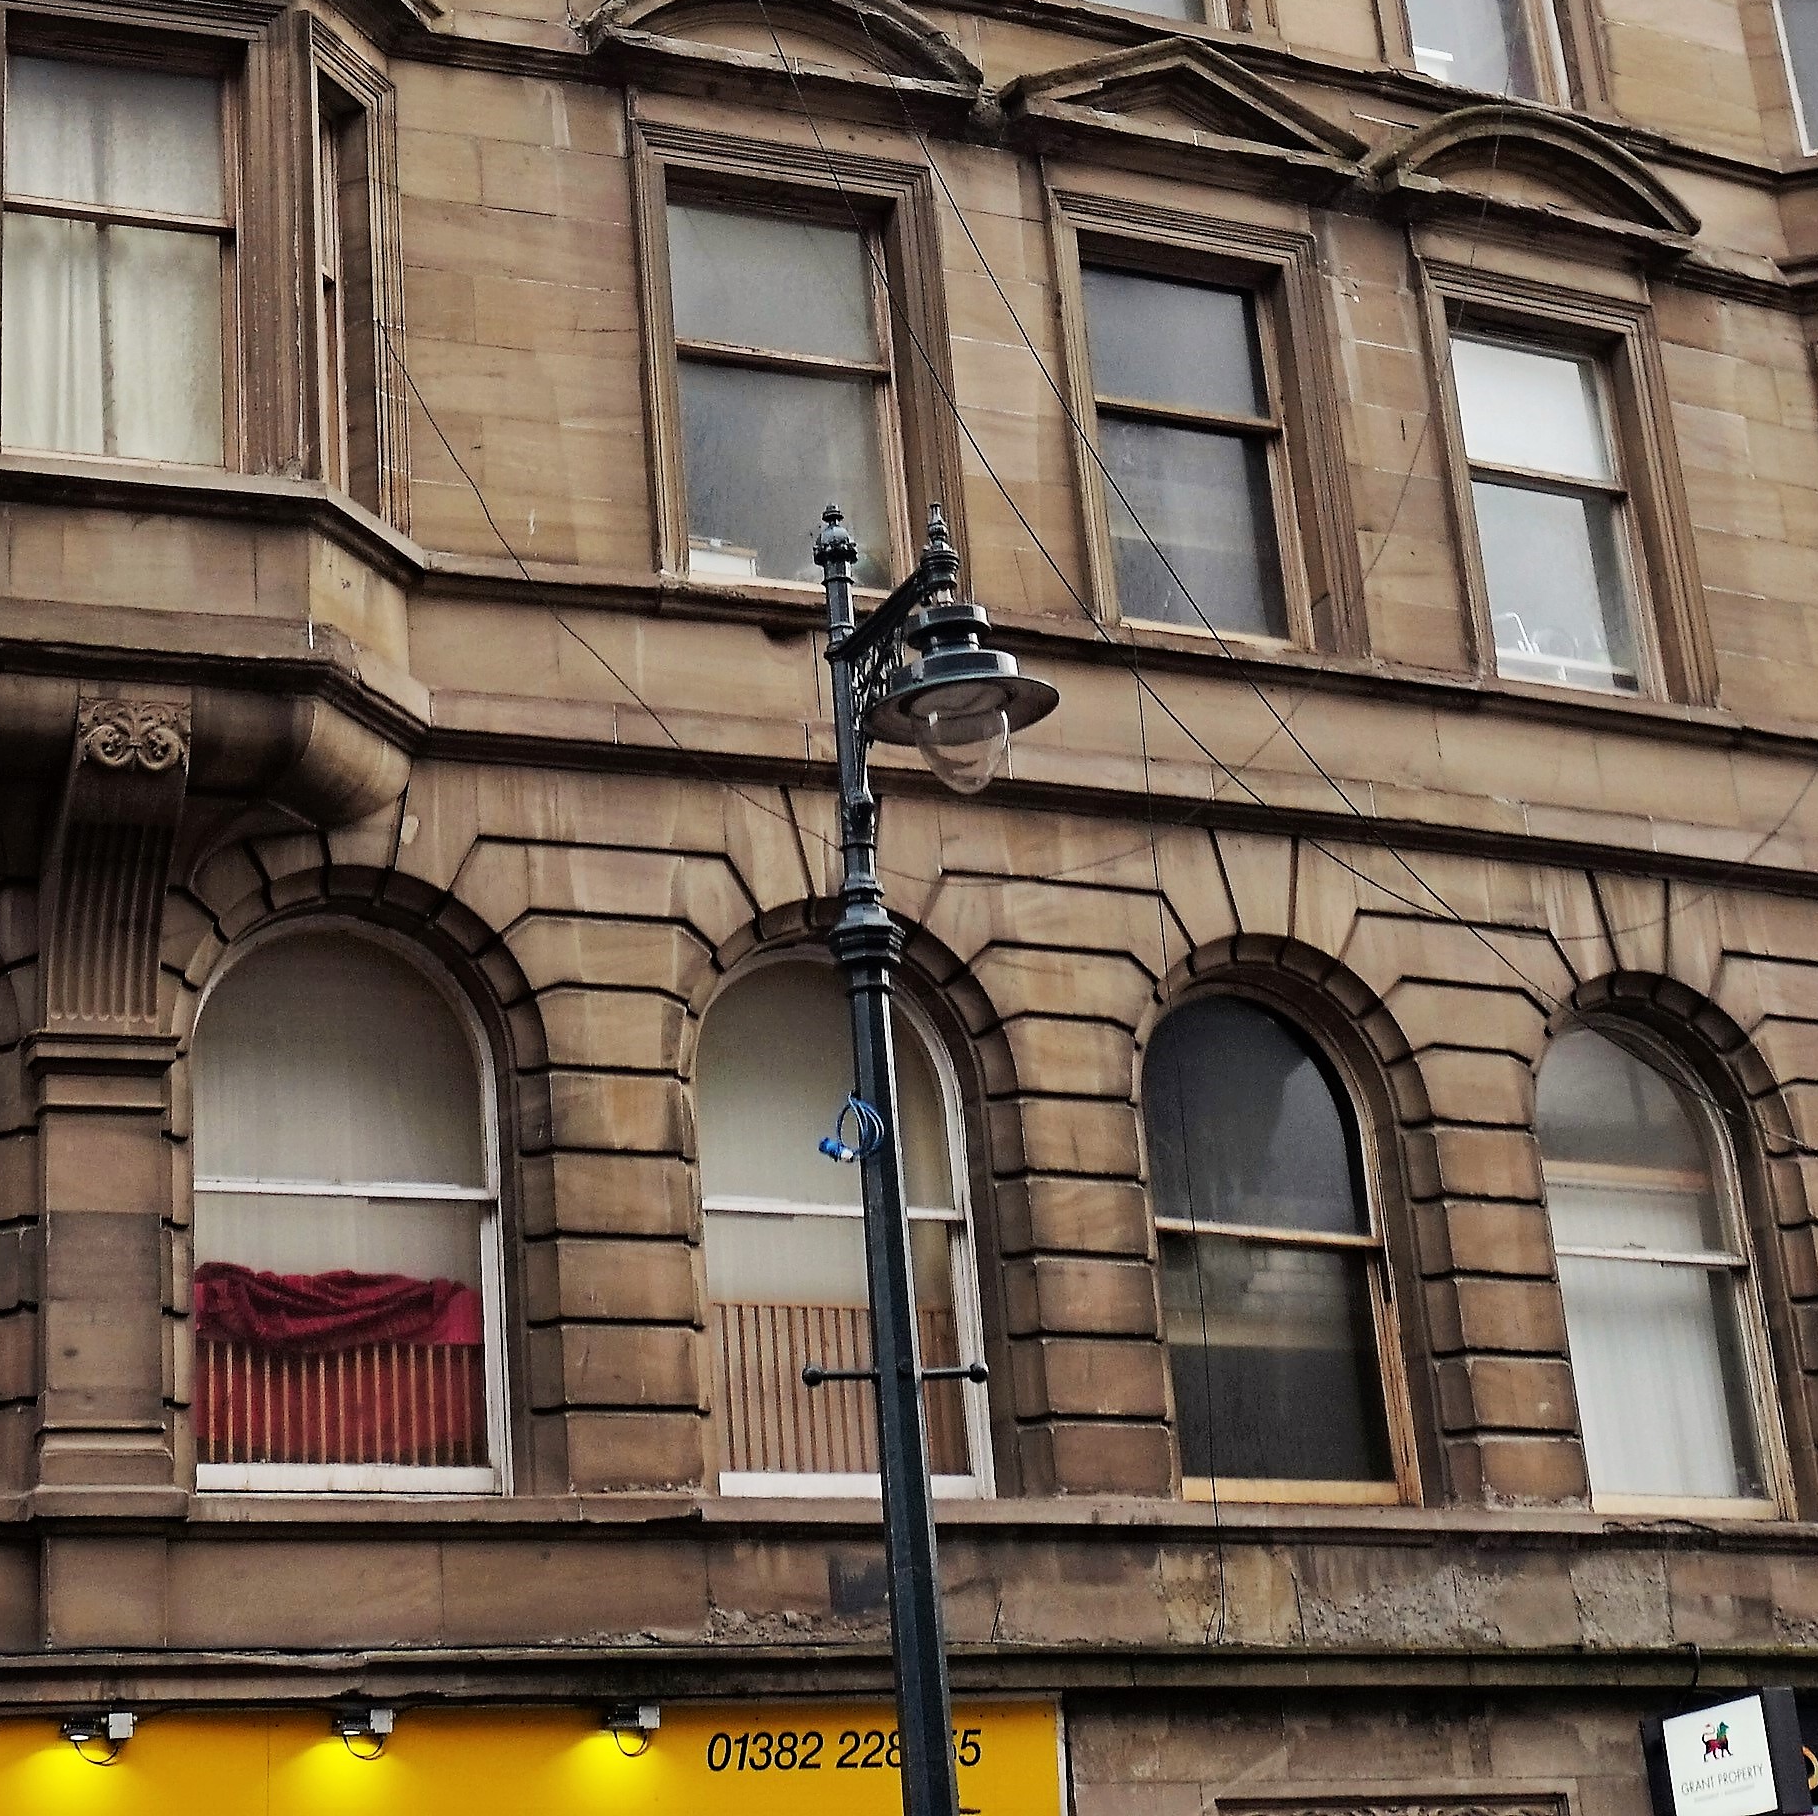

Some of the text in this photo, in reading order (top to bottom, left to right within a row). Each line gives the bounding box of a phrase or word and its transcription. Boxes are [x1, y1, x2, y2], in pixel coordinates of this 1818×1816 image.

[707, 1729, 982, 1771] 01382 2285
[1681, 1776, 1715, 1796] GRANT
[1717, 1764, 1764, 1785] PROPERTY
